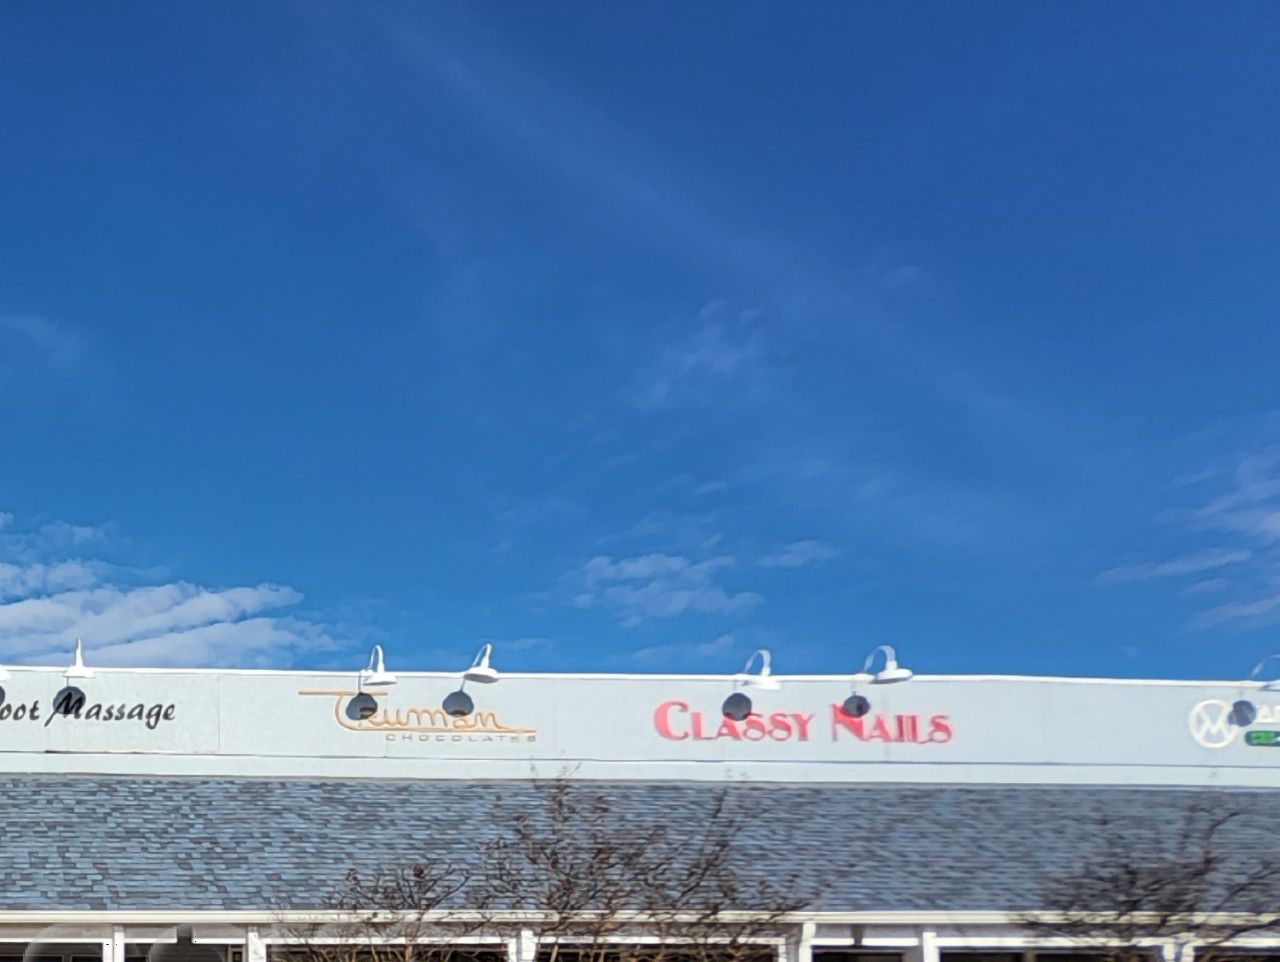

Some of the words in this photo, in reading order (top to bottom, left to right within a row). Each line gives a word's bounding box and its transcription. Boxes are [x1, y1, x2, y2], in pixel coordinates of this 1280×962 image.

[44, 691, 176, 730] Massage
[652, 700, 816, 742] CLASSY
[830, 703, 953, 745] NAILS
[385, 733, 537, 743] CHOCOLATES
